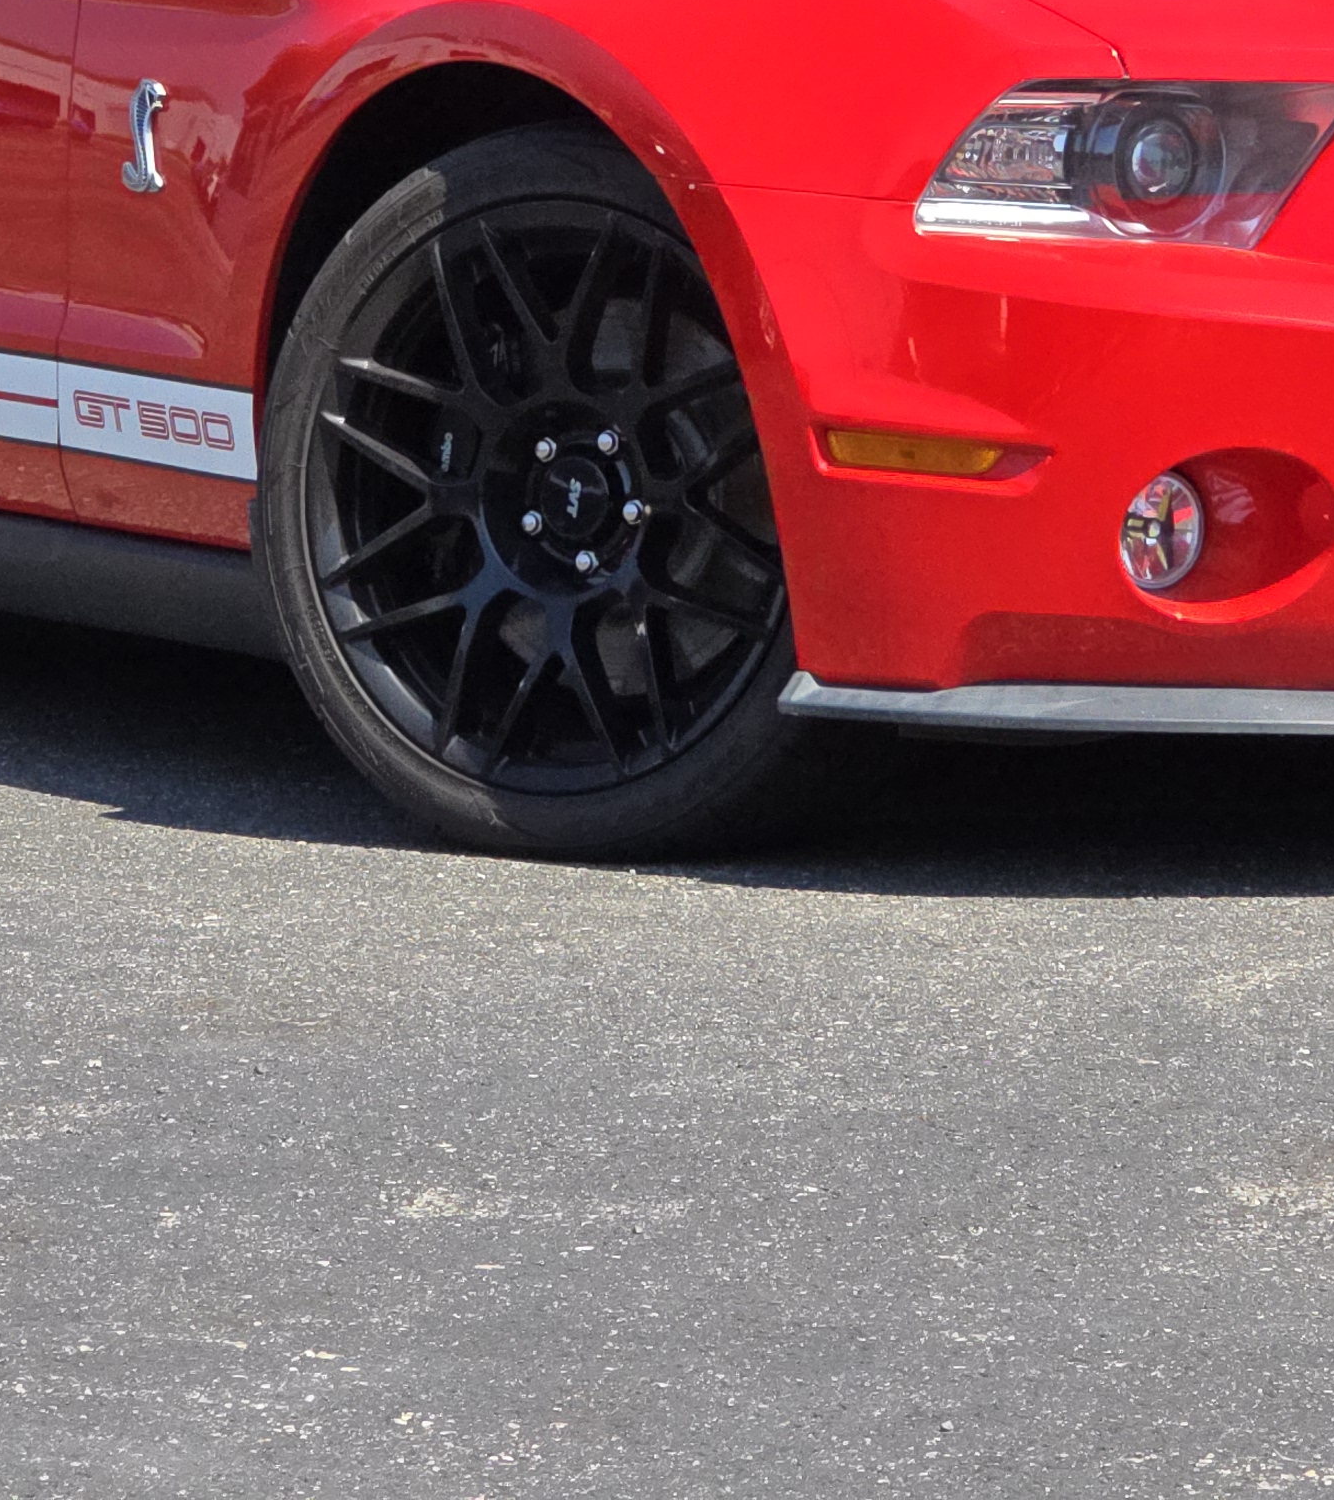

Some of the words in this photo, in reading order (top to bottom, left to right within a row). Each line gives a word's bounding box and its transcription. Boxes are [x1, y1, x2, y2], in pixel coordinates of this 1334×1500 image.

[73, 389, 131, 433] GT
[136, 400, 236, 452] 500
[566, 477, 582, 519] SVT
